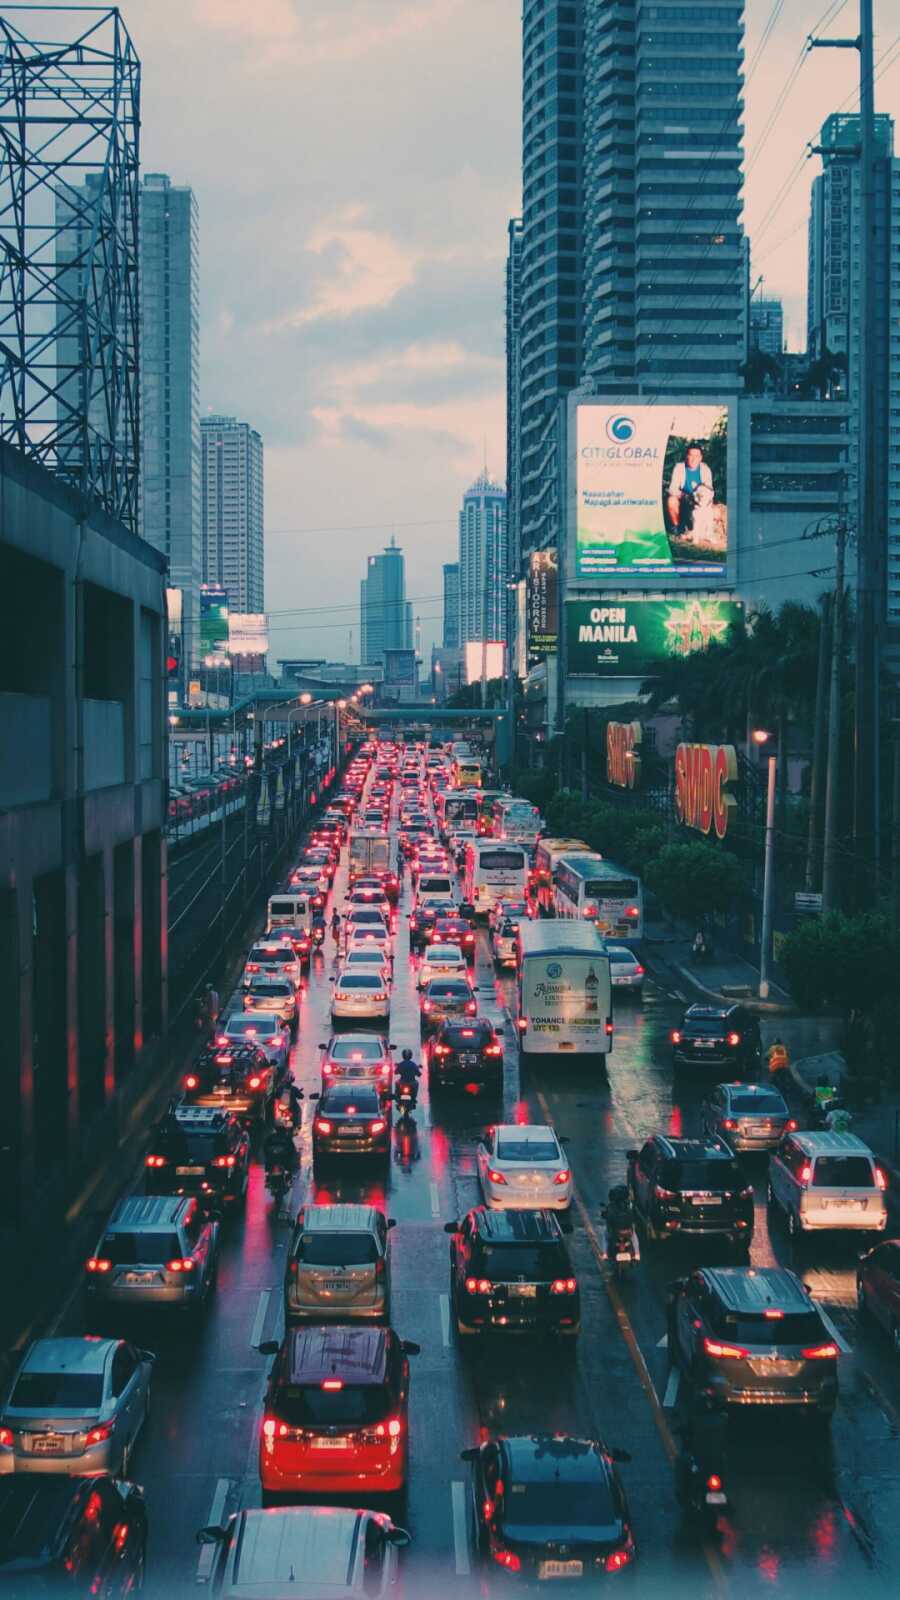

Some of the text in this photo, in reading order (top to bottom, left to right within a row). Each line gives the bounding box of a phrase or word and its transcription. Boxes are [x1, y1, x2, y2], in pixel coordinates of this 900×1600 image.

[581, 447, 659, 459] CITIGLOBAL
[590, 608, 626, 623] OPEN
[578, 625, 638, 642] MANILA
